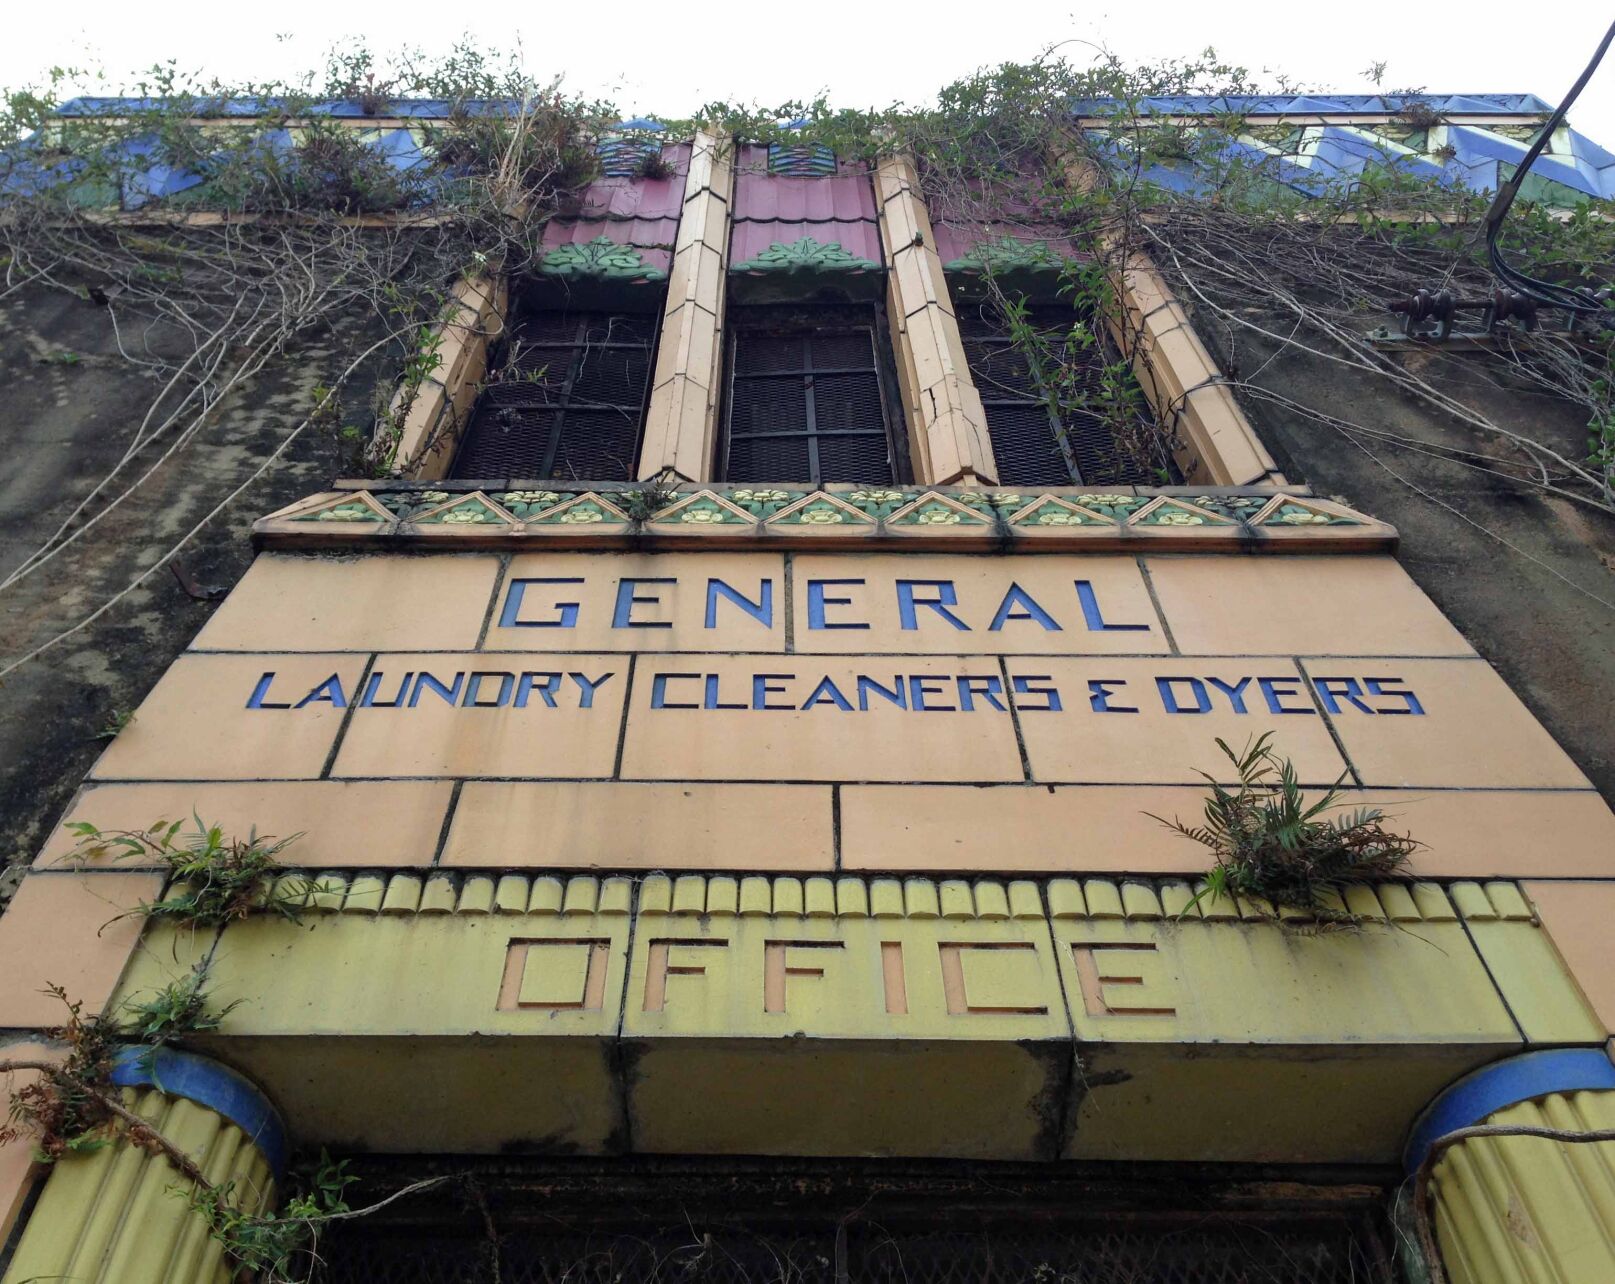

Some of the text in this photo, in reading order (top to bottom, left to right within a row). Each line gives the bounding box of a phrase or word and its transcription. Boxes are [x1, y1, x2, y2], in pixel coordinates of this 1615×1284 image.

[500, 579, 1149, 631] GENERAL
[246, 672, 1425, 715] LAUNDRY CLEANERS & DYERS
[496, 937, 1177, 1017] OFFICE
